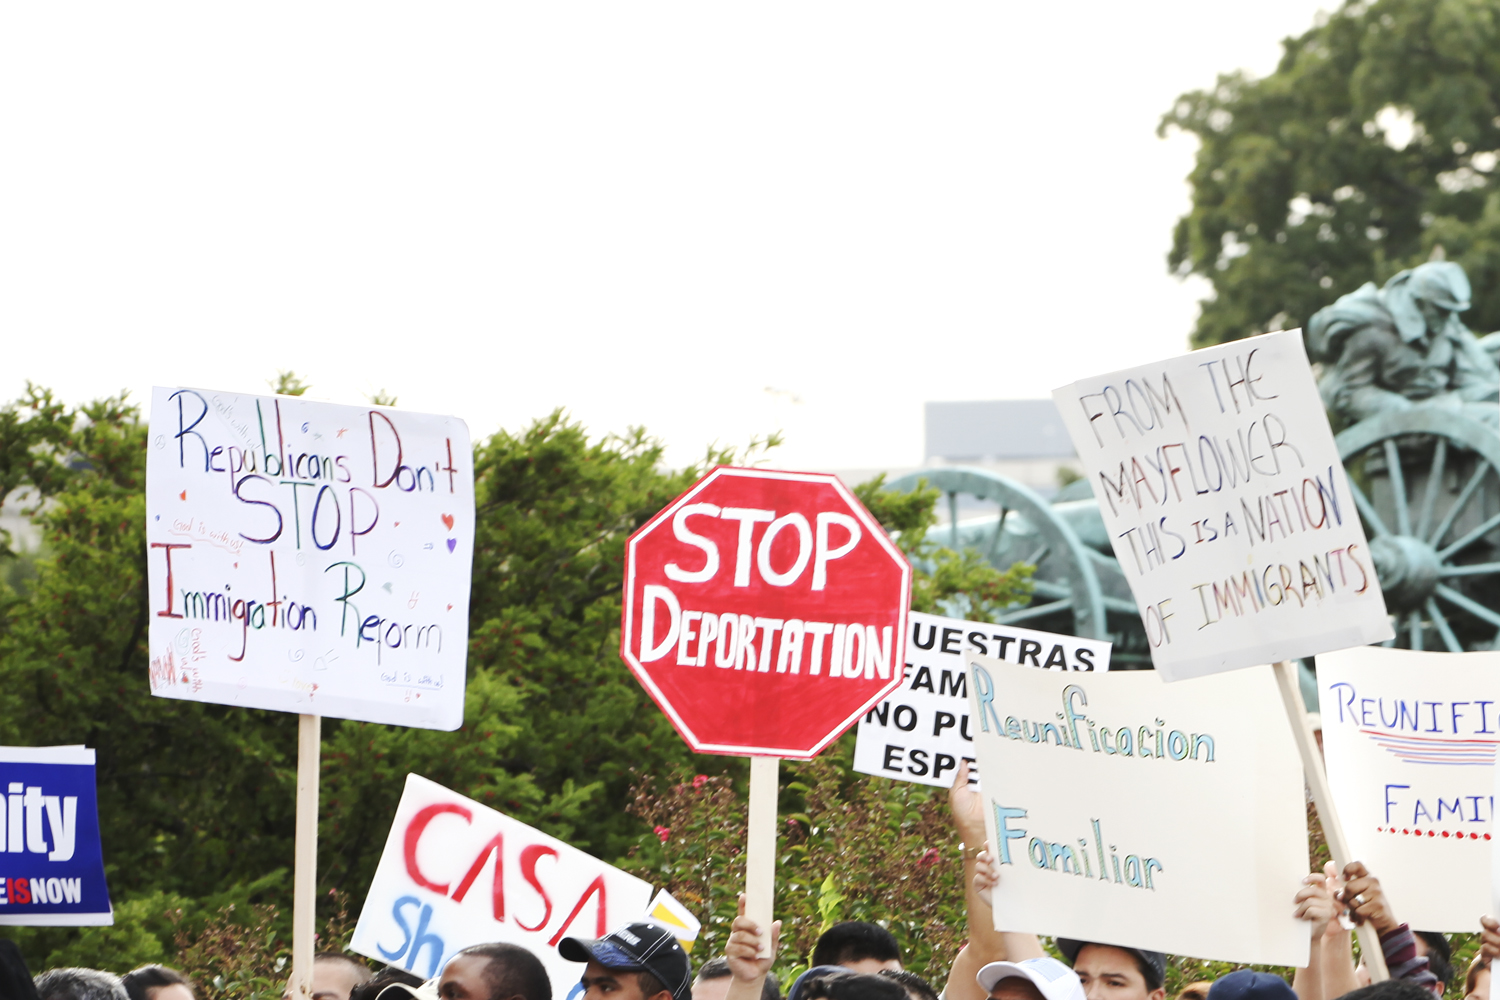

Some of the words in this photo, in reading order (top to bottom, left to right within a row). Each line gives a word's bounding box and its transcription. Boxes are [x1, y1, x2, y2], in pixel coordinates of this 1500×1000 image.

[168, 389, 351, 495] Republicans
[369, 410, 458, 495] Don't
[1079, 371, 1190, 449] FROM
[1198, 348, 1280, 414] THE
[1099, 412, 1305, 518] MAYFLOWER
[235, 473, 379, 556] STOP
[664, 502, 862, 592] STOP
[1118, 516, 1187, 576] THIS
[1191, 518, 1219, 544] IS
[1223, 511, 1239, 538] A
[1240, 465, 1343, 547] NATION
[151, 542, 317, 662] Immigration
[325, 561, 443, 666] Reform
[640, 584, 893, 681] DEPORTATION
[1145, 597, 1176, 648] OF
[1191, 543, 1370, 632] IMMIGRANTS
[903, 662, 968, 700] AM
[912, 621, 1096, 673] UESTRAS
[864, 700, 918, 733] NO
[932, 710, 974, 742] PU
[970, 660, 1216, 764] Reunificacion
[882, 743, 979, 786] ESPE
[0, 781, 78, 862] ity
[991, 798, 1164, 892] Familiar
[403, 802, 609, 948] CASA
